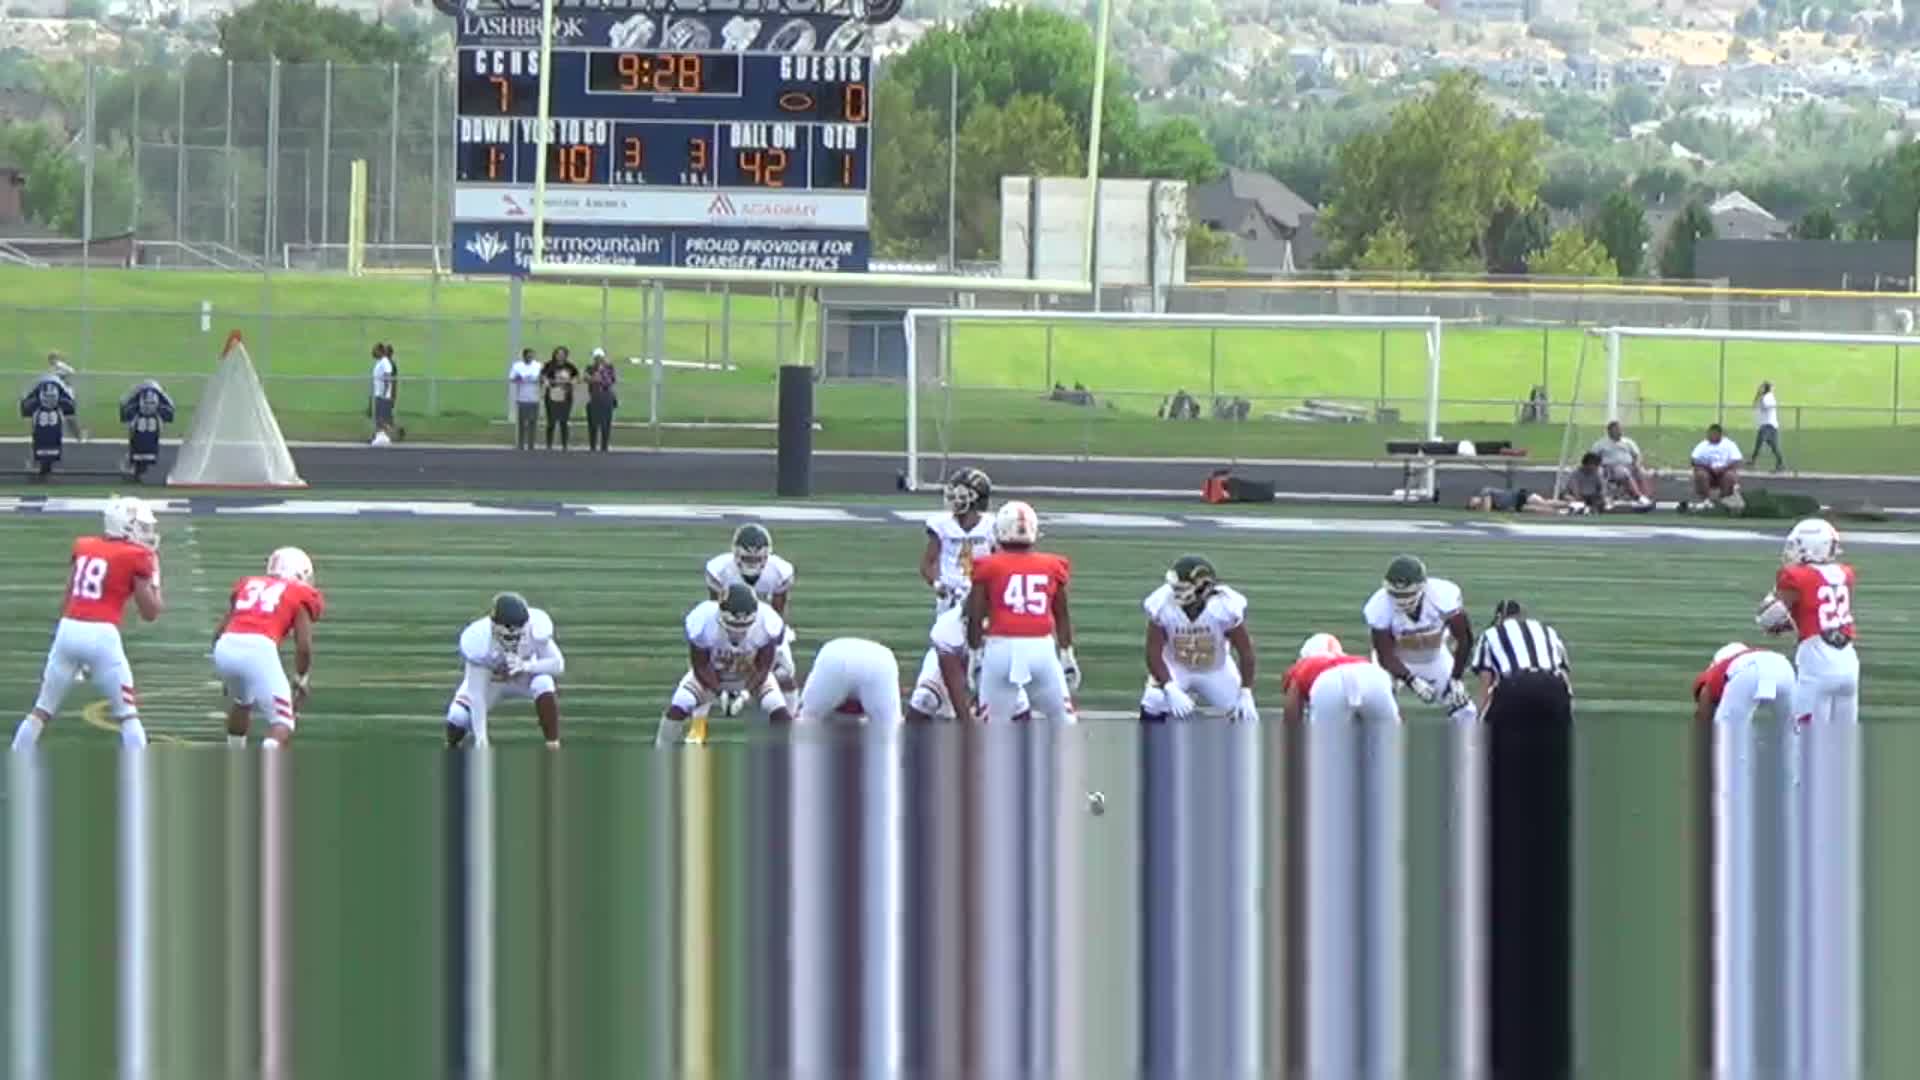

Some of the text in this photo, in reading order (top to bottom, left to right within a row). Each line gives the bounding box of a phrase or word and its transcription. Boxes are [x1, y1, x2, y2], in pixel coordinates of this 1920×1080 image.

[463, 15, 584, 37] LASHBROK
[618, 53, 700, 91] 9:28
[780, 55, 862, 81] GUESTS
[489, 76, 509, 112] 7
[845, 84, 866, 121] 0
[461, 119, 511, 143] DOWN
[560, 119, 580, 145] TO
[583, 119, 607, 145] GO
[731, 123, 796, 149] BALL ON
[823, 124, 857, 149] QTR
[559, 144, 592, 182] 10
[625, 136, 642, 168] 3
[690, 138, 706, 170] 3
[740, 149, 786, 187] 42
[843, 152, 852, 186] 1
[514, 231, 660, 253] Inermountain
[685, 238, 853, 256] PROUD PROVIDER FOR
[514, 252, 563, 268] Sprts
[685, 254, 840, 271] CHARGER ATHLETICS
[71, 554, 109, 601] 18
[234, 579, 288, 613] 34
[1003, 573, 1050, 616] 45
[1817, 584, 1855, 631] 22
